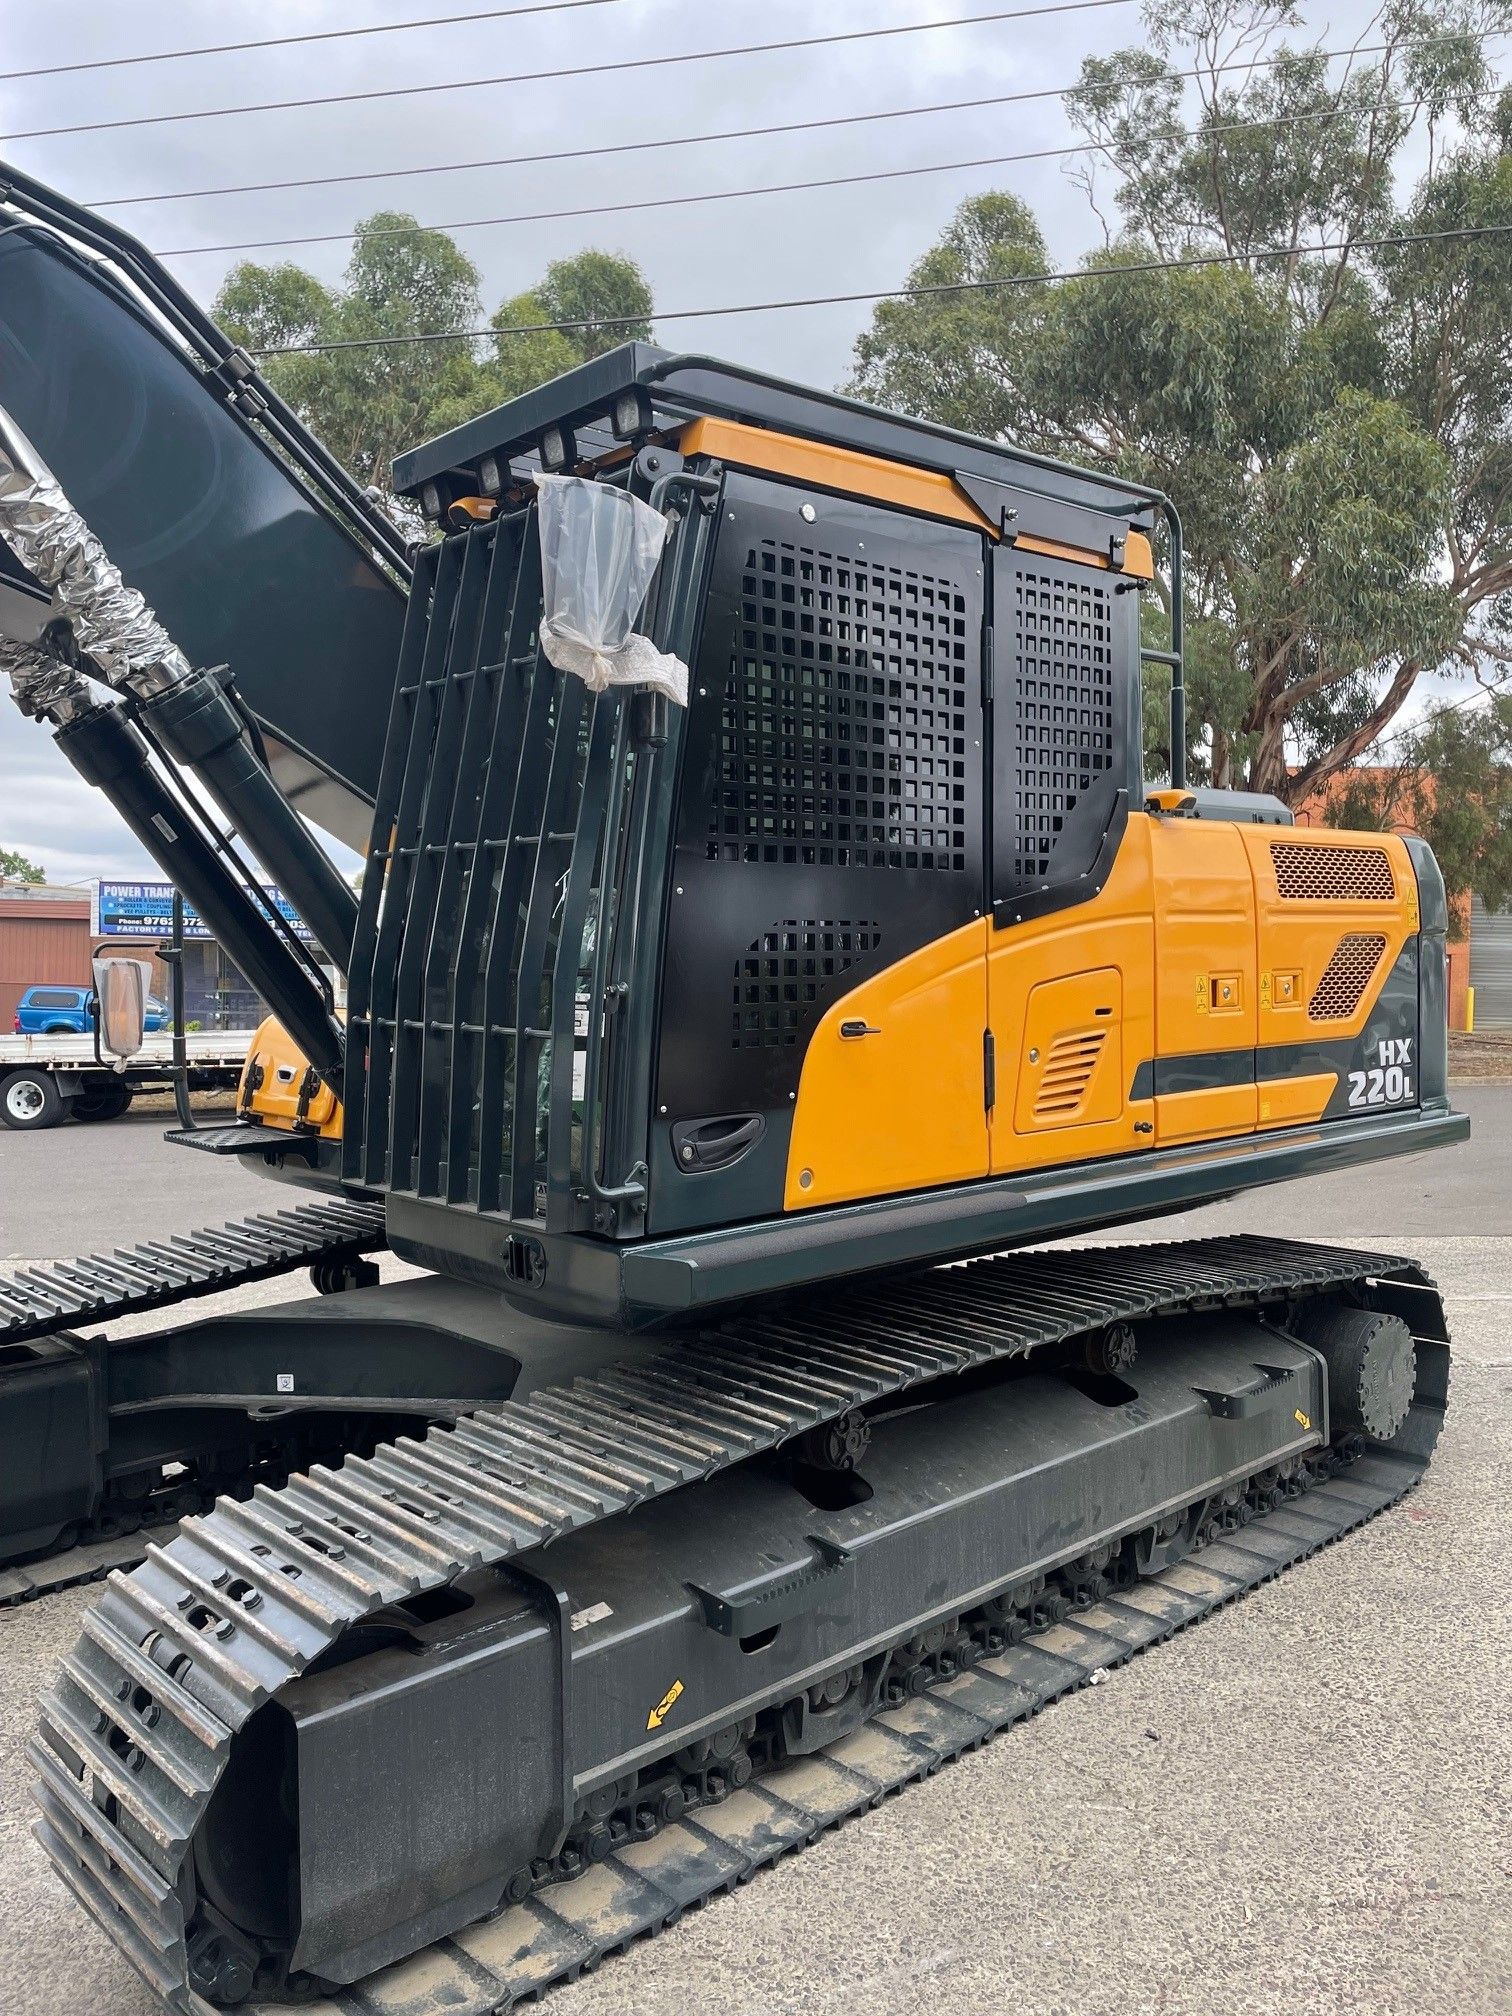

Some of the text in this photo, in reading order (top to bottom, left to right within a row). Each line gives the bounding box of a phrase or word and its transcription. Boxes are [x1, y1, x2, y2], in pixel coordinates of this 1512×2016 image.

[103, 885, 176, 898] POWER TRANS
[116, 925, 158, 933] FACTORY
[1378, 1037, 1412, 1067] HX
[1347, 1066, 1414, 1108] 220L
